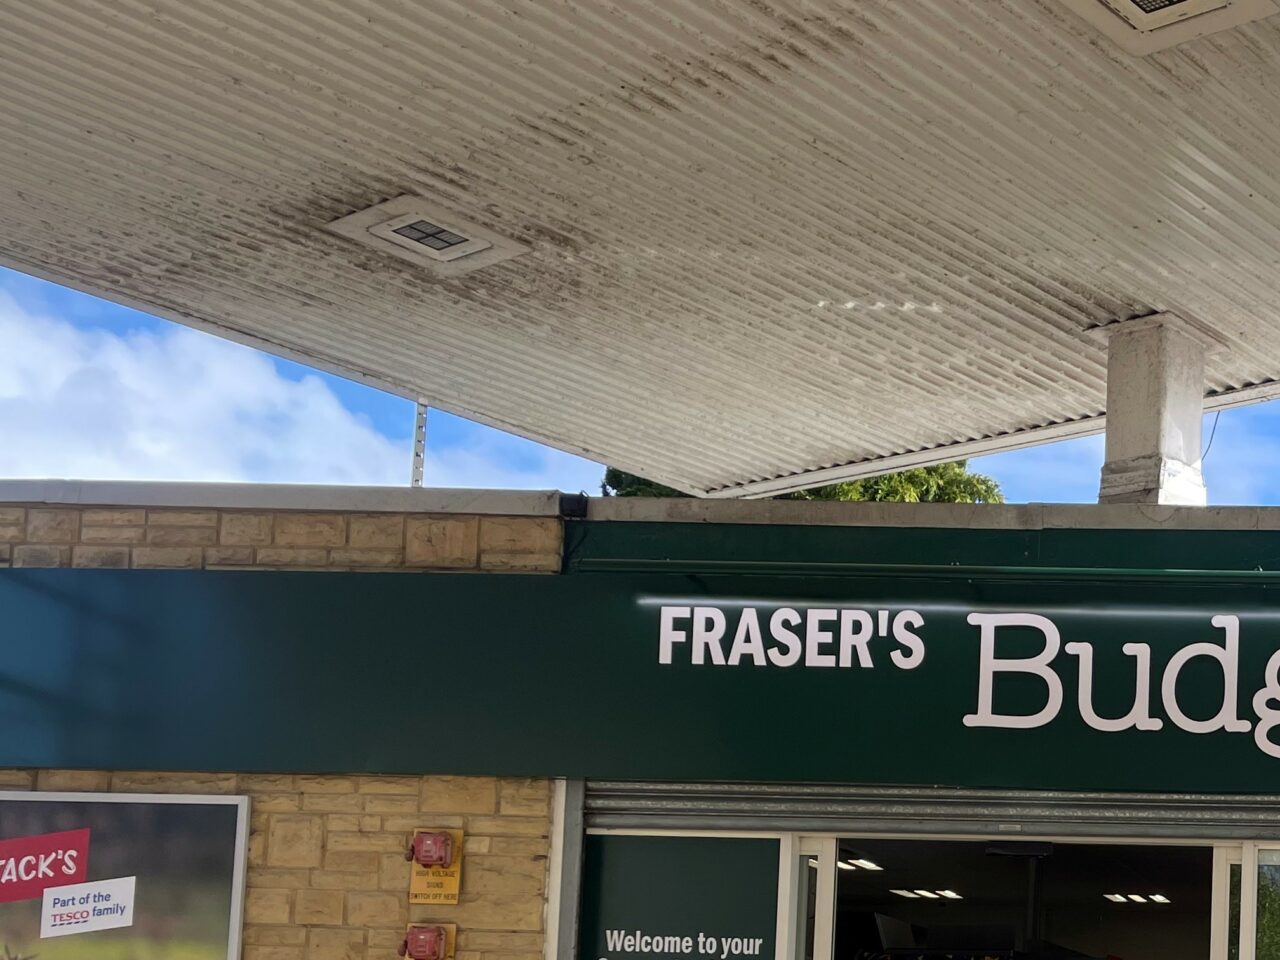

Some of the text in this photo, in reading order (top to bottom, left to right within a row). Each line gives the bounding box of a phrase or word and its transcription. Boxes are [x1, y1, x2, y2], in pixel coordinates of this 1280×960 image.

[658, 604, 927, 670] FRASER'S
[431, 870, 456, 878] VOLTAGE
[52, 891, 112, 909] Part of the
[50, 903, 127, 923] TESCO family
[605, 929, 763, 959] Welcome to your
